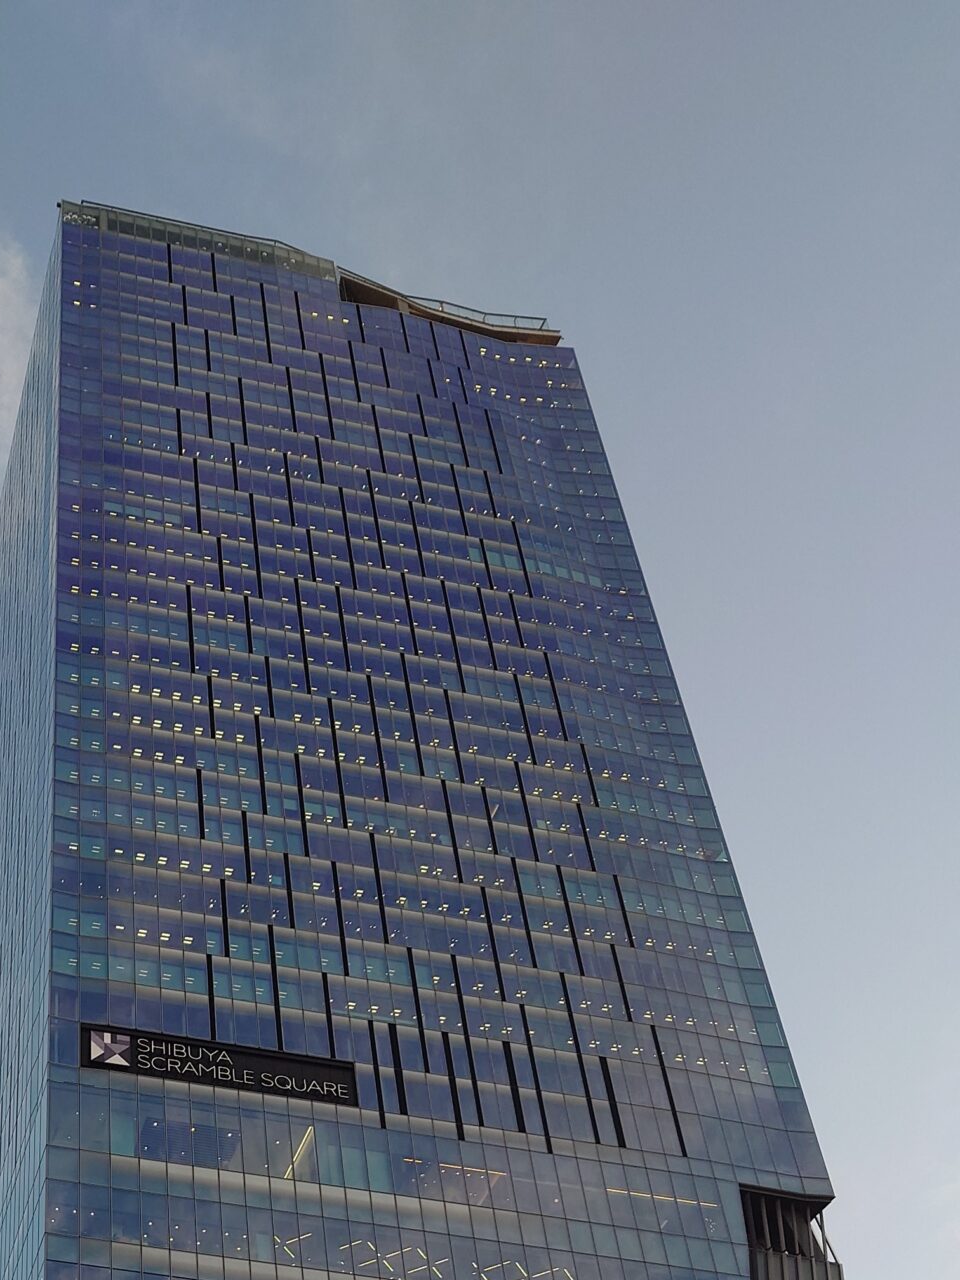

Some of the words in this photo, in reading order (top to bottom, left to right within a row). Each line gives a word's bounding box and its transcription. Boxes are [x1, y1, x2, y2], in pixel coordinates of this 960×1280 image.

[137, 1038, 233, 1065] SHIBUYA
[137, 1054, 255, 1085] SCRAMBLE
[260, 1072, 349, 1099] SQUARE
